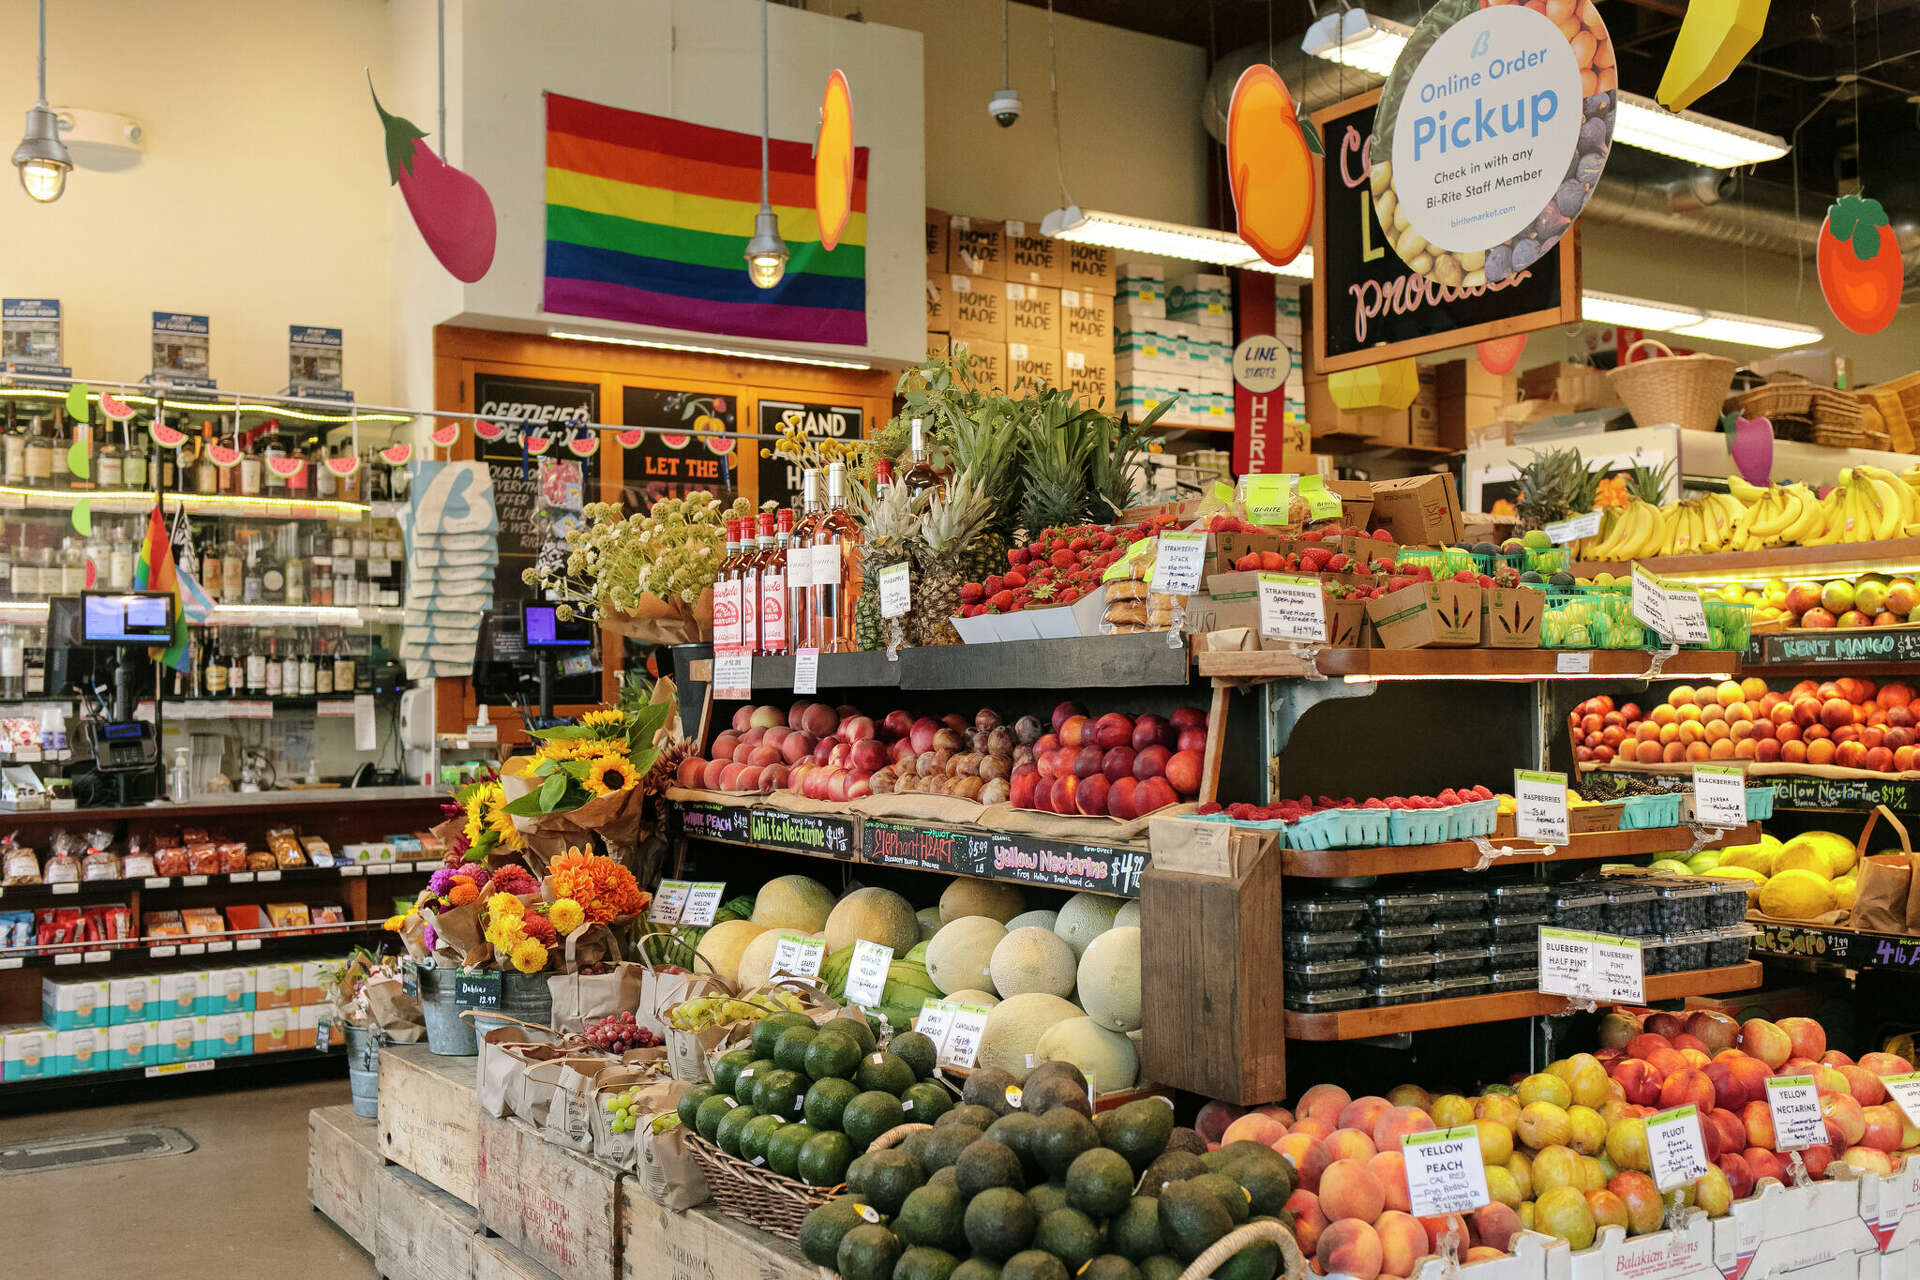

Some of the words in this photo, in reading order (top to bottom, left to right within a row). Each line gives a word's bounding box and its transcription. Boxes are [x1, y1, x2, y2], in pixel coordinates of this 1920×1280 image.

[1420, 73, 1481, 103] Online
[1488, 49, 1547, 80] Order
[1414, 89, 1559, 162] Pickup
[1434, 165, 1467, 184] Check
[1470, 162, 1481, 174] in
[1484, 153, 1508, 169] with
[1512, 149, 1534, 163] any
[1426, 189, 1462, 209] Bi-Rite
[1466, 180, 1491, 198] Staff
[1495, 168, 1543, 190] Member
[1450, 205, 1516, 228] biritemarket.com
[1014, 236, 1054, 253] HOME
[1014, 252, 1054, 269] MADE
[1070, 244, 1108, 262] HOME
[1070, 261, 1108, 277] MADE
[958, 291, 998, 309] HOME
[1014, 298, 1053, 316] HOME
[958, 307, 998, 325] MADE
[1069, 305, 1105, 322] HOME
[1014, 314, 1053, 331] MADE
[1069, 321, 1106, 337] MADE
[1245, 346, 1279, 361] LINE
[1016, 360, 1054, 376] HOME
[1244, 367, 1277, 379] STARTS
[1070, 380, 1107, 396] MADE
[1249, 396, 1268, 474] HERE
[645, 456, 680, 475] LET
[685, 458, 719, 478] THE
[1265, 588, 1317, 599] STRAWBERRIES
[1783, 639, 1830, 658] KENT
[1834, 635, 1895, 658] MANGO
[1698, 777, 1741, 787] BLACKBERRIES
[1523, 792, 1561, 804] RASPBERRIES
[1818, 780, 1880, 803] Nectarine
[706, 814, 733, 832] PEACH
[752, 815, 781, 841] White
[782, 818, 825, 848] Nectarine
[932, 829, 950, 839] PLUOT
[975, 863, 985, 873] LB
[1039, 850, 1108, 880] Nectarine
[1546, 942, 1589, 954] BLUEBERRY
[1600, 950, 1634, 961] BLUEBERRY
[1549, 956, 1568, 966] HALF
[1570, 958, 1587, 968] PINT
[1610, 962, 1625, 970] PINT
[479, 995, 497, 1005] 12.99
[1779, 1089, 1807, 1099] YELLOW
[1776, 1103, 1817, 1114] NECTARINE
[1662, 1126, 1685, 1139] PLUOT
[1419, 1143, 1464, 1157] YELLOW
[1426, 1160, 1464, 1174] PEACH
[1616, 1249, 1663, 1272] Balakian
